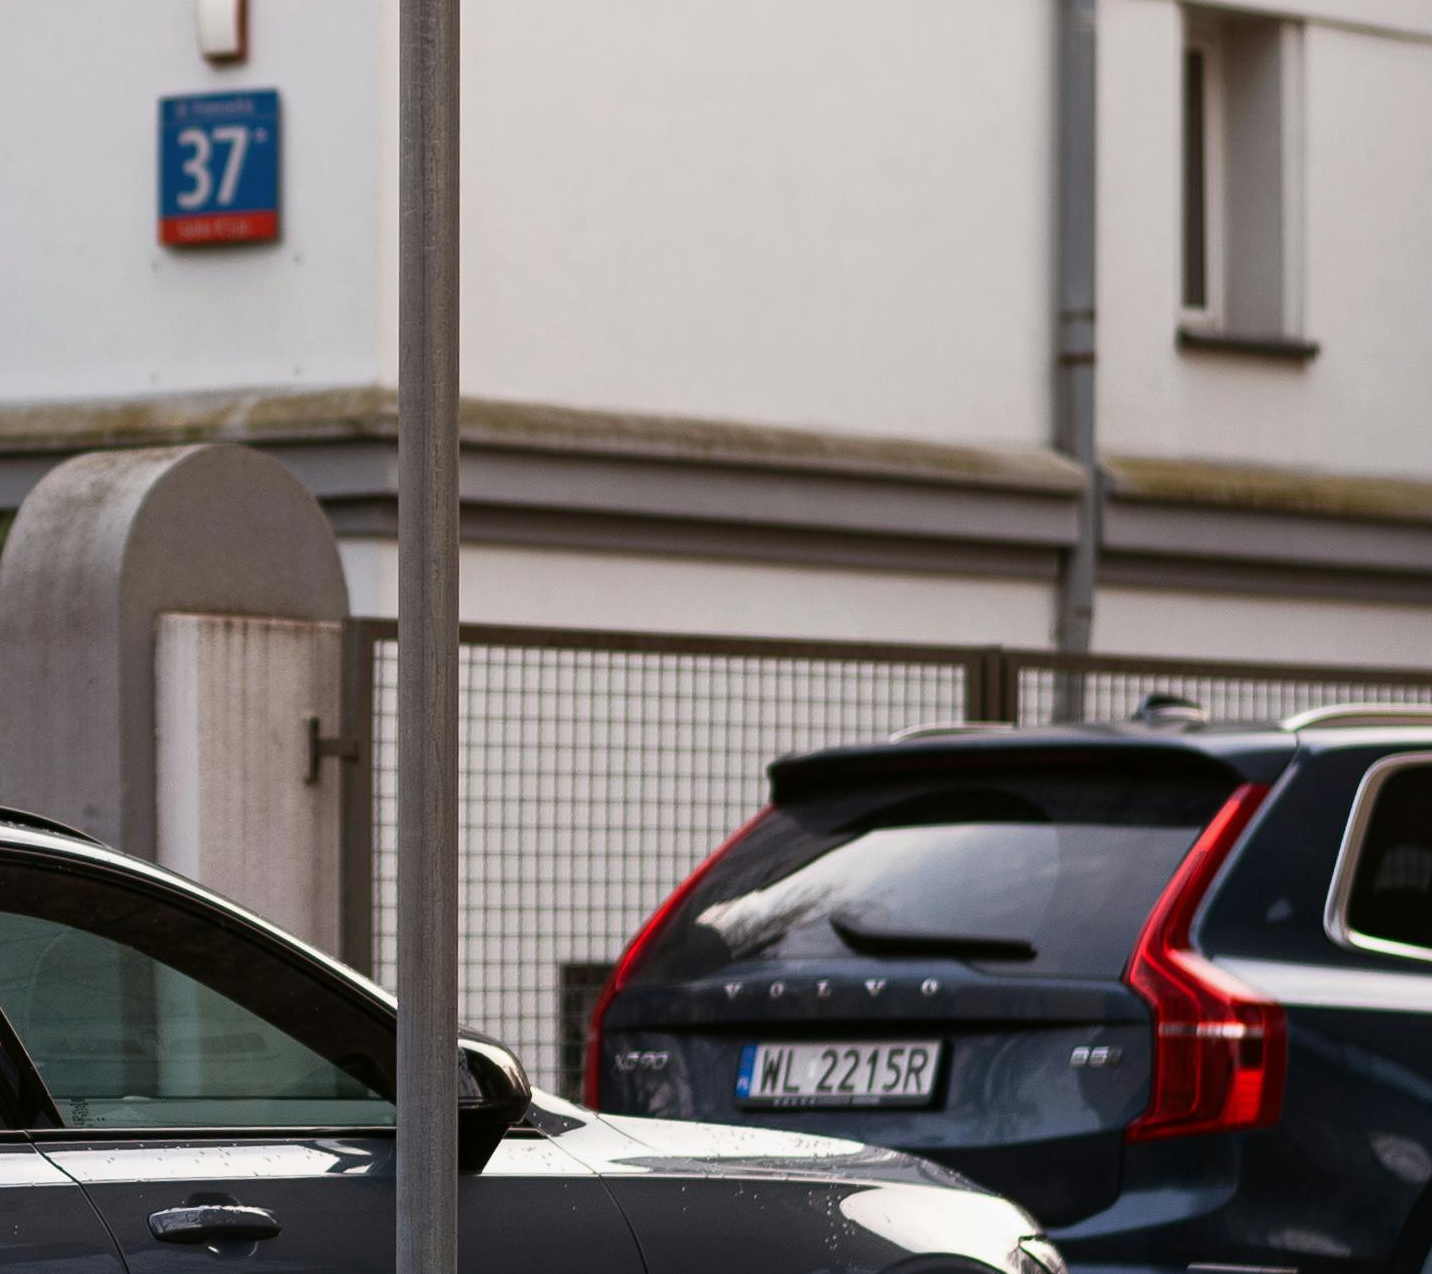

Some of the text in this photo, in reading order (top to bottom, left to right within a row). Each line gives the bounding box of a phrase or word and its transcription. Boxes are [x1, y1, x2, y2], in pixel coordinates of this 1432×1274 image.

[177, 127, 248, 209] 37
[723, 978, 940, 998] VOLVO
[760, 1047, 929, 1094] WL 2215R
